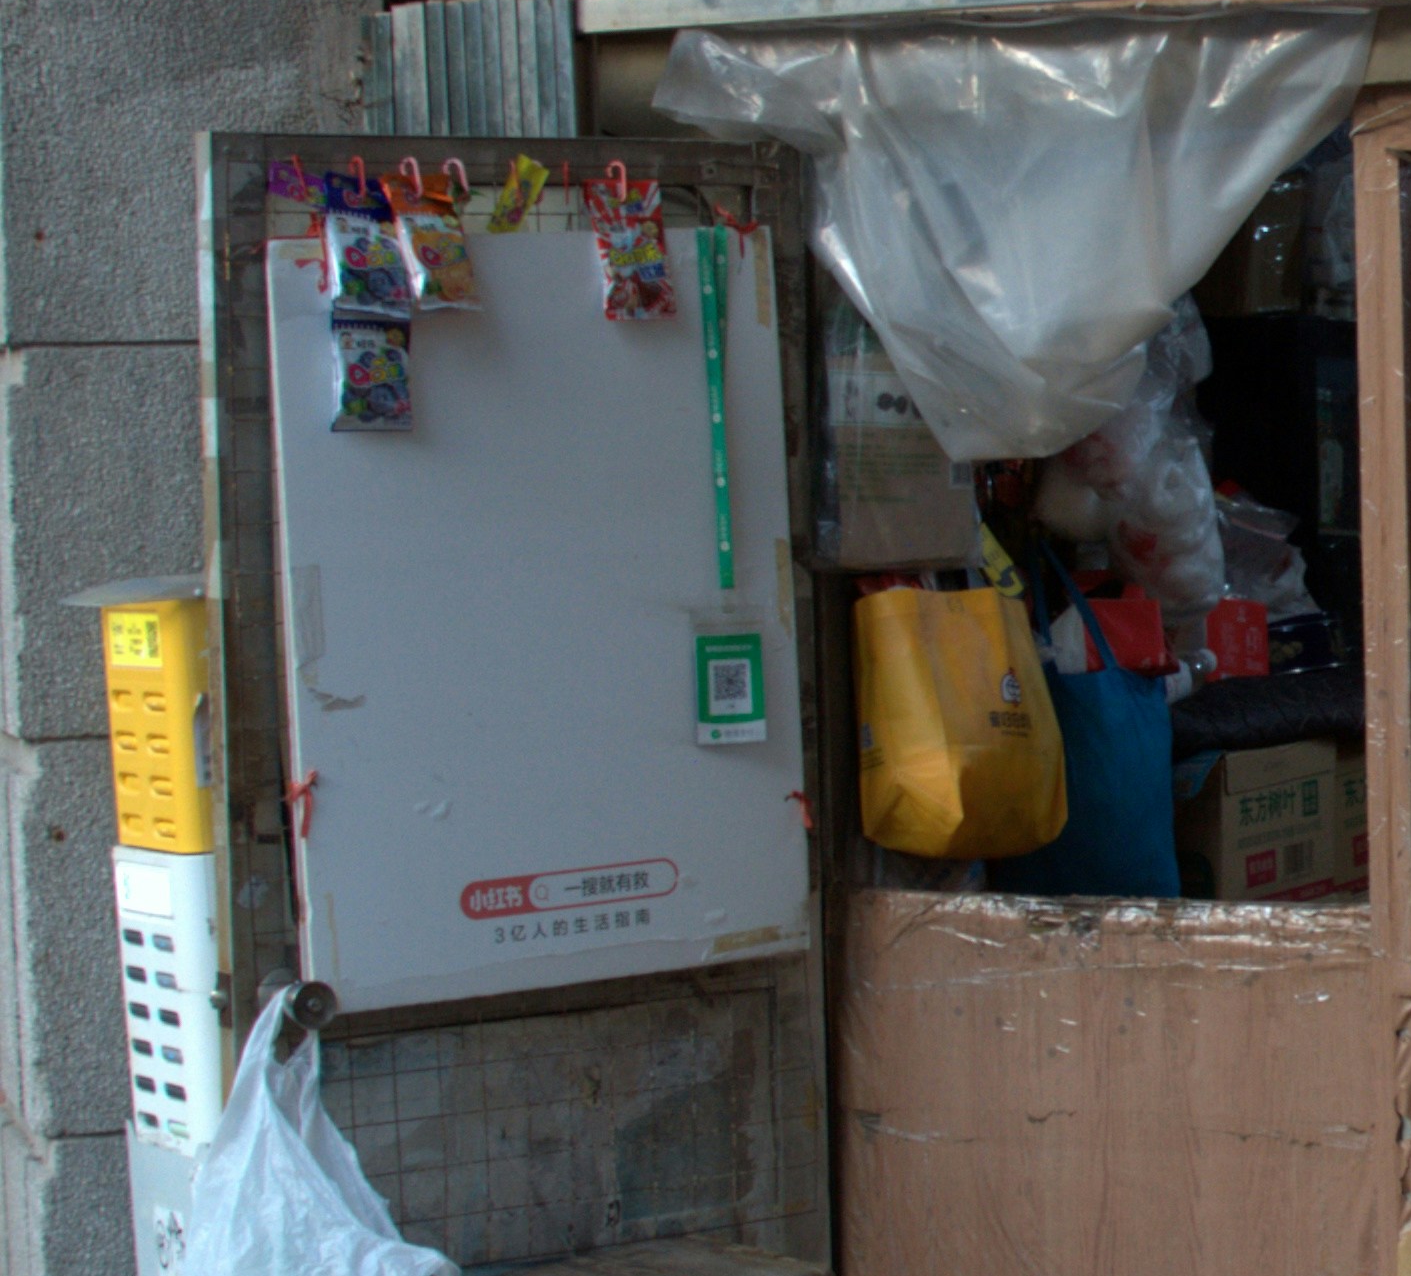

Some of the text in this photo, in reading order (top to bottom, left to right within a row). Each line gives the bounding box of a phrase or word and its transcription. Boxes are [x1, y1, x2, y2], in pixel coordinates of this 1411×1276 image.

[469, 870, 650, 911] 小红书 一搜就有救
[494, 908, 651, 944] 3亿人的生活指南
